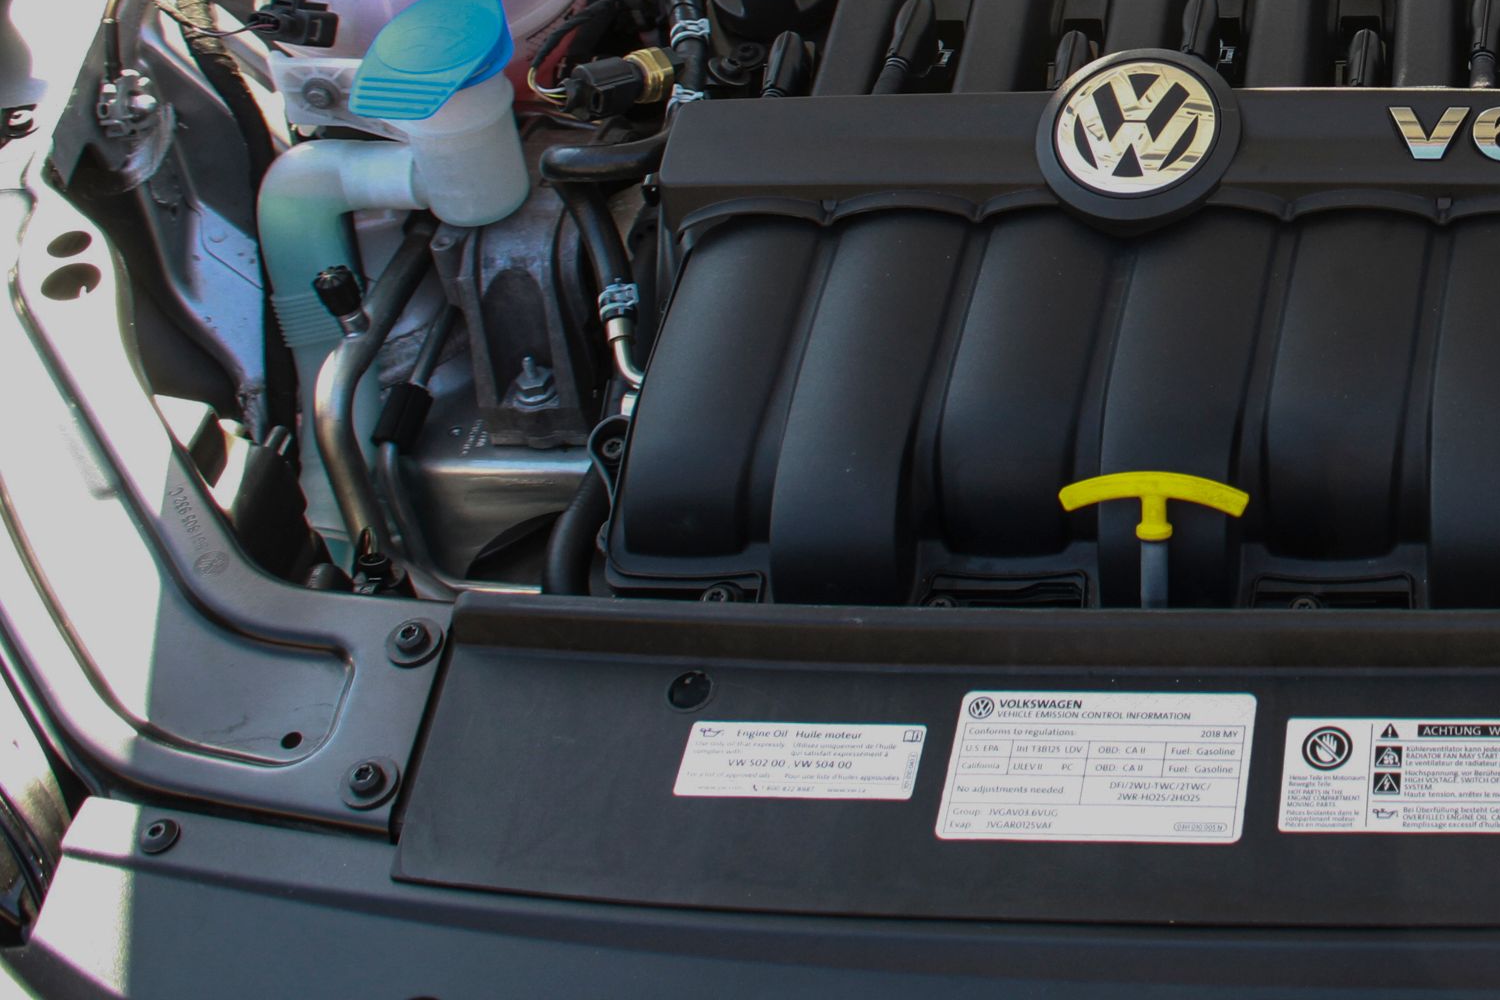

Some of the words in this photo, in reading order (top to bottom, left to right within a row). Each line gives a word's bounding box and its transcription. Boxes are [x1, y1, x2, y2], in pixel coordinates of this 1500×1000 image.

[1000, 699, 1083, 709] VOLKSWAGEN
[997, 710, 1032, 718] VEHICLE
[1035, 711, 1079, 719] EMISSION
[1082, 711, 1123, 719] CONTROL
[1126, 711, 1191, 720] INFORMATION
[737, 729, 771, 739] Engine
[773, 729, 788, 738] Oil
[825, 731, 863, 739] moteur
[1200, 730, 1221, 738] 2018
[1223, 730, 1238, 738] MY
[1423, 726, 1481, 736] ACHTUNG
[1125, 746, 1140, 754] CA
[1171, 747, 1192, 755] Fuel:
[1196, 747, 1235, 756] Gasoline
[728, 759, 747, 767] VW
[749, 759, 768, 767] 502
[794, 760, 813, 768] VW
[838, 761, 853, 769] 00
[1061, 763, 1074, 771] PC
[1122, 764, 1136, 772] CA
[1194, 765, 1233, 774] Gasoline
[972, 785, 1028, 795] adjustments
[1030, 786, 1064, 794] needed
[1461, 806, 1488, 814] besteht
[1402, 821, 1446, 829] Remplissage
